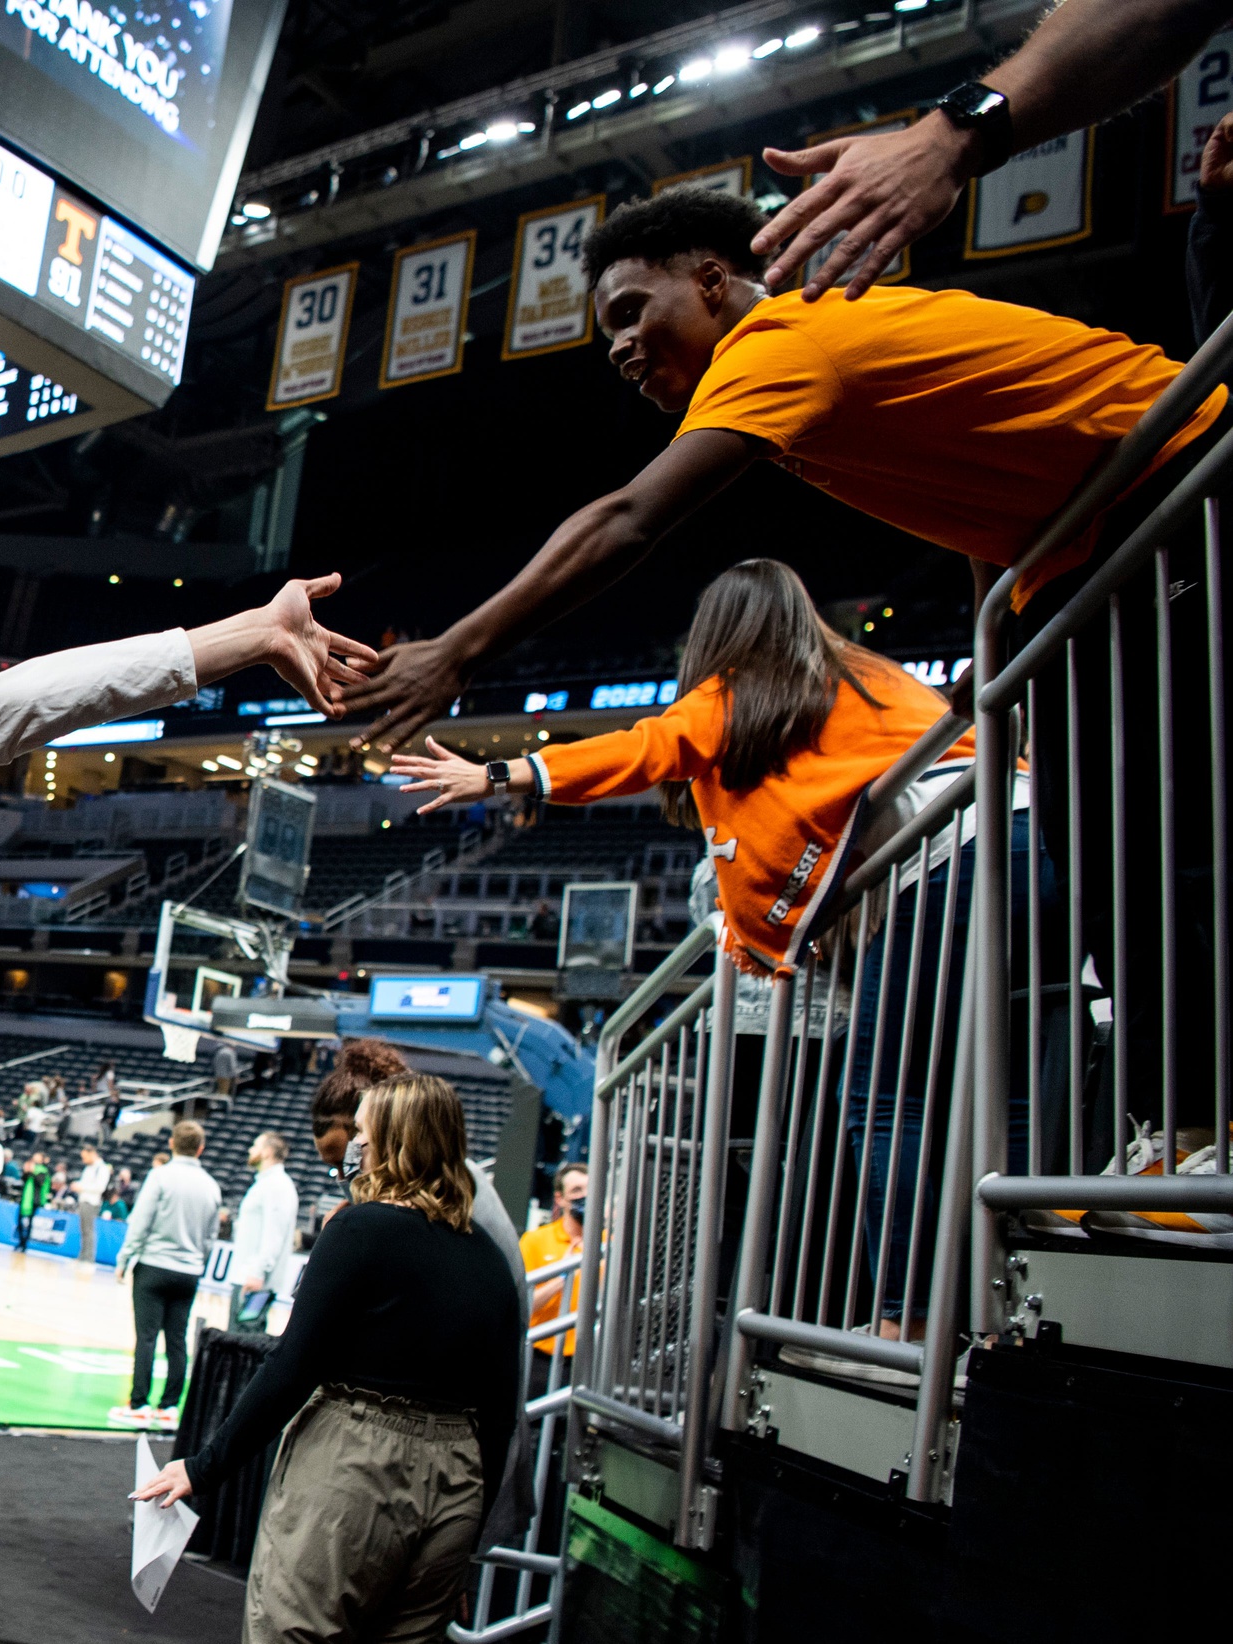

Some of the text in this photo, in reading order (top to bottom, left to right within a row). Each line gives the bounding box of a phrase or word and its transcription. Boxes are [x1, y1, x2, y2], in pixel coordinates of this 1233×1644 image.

[58, 27, 179, 132] ATTENDING
[122, 32, 179, 99] YOU
[55, 198, 97, 266] T
[533, 216, 586, 270] 34
[295, 284, 339, 330] 30
[411, 261, 448, 306] 31
[766, 840, 823, 926] TENNESSEE
